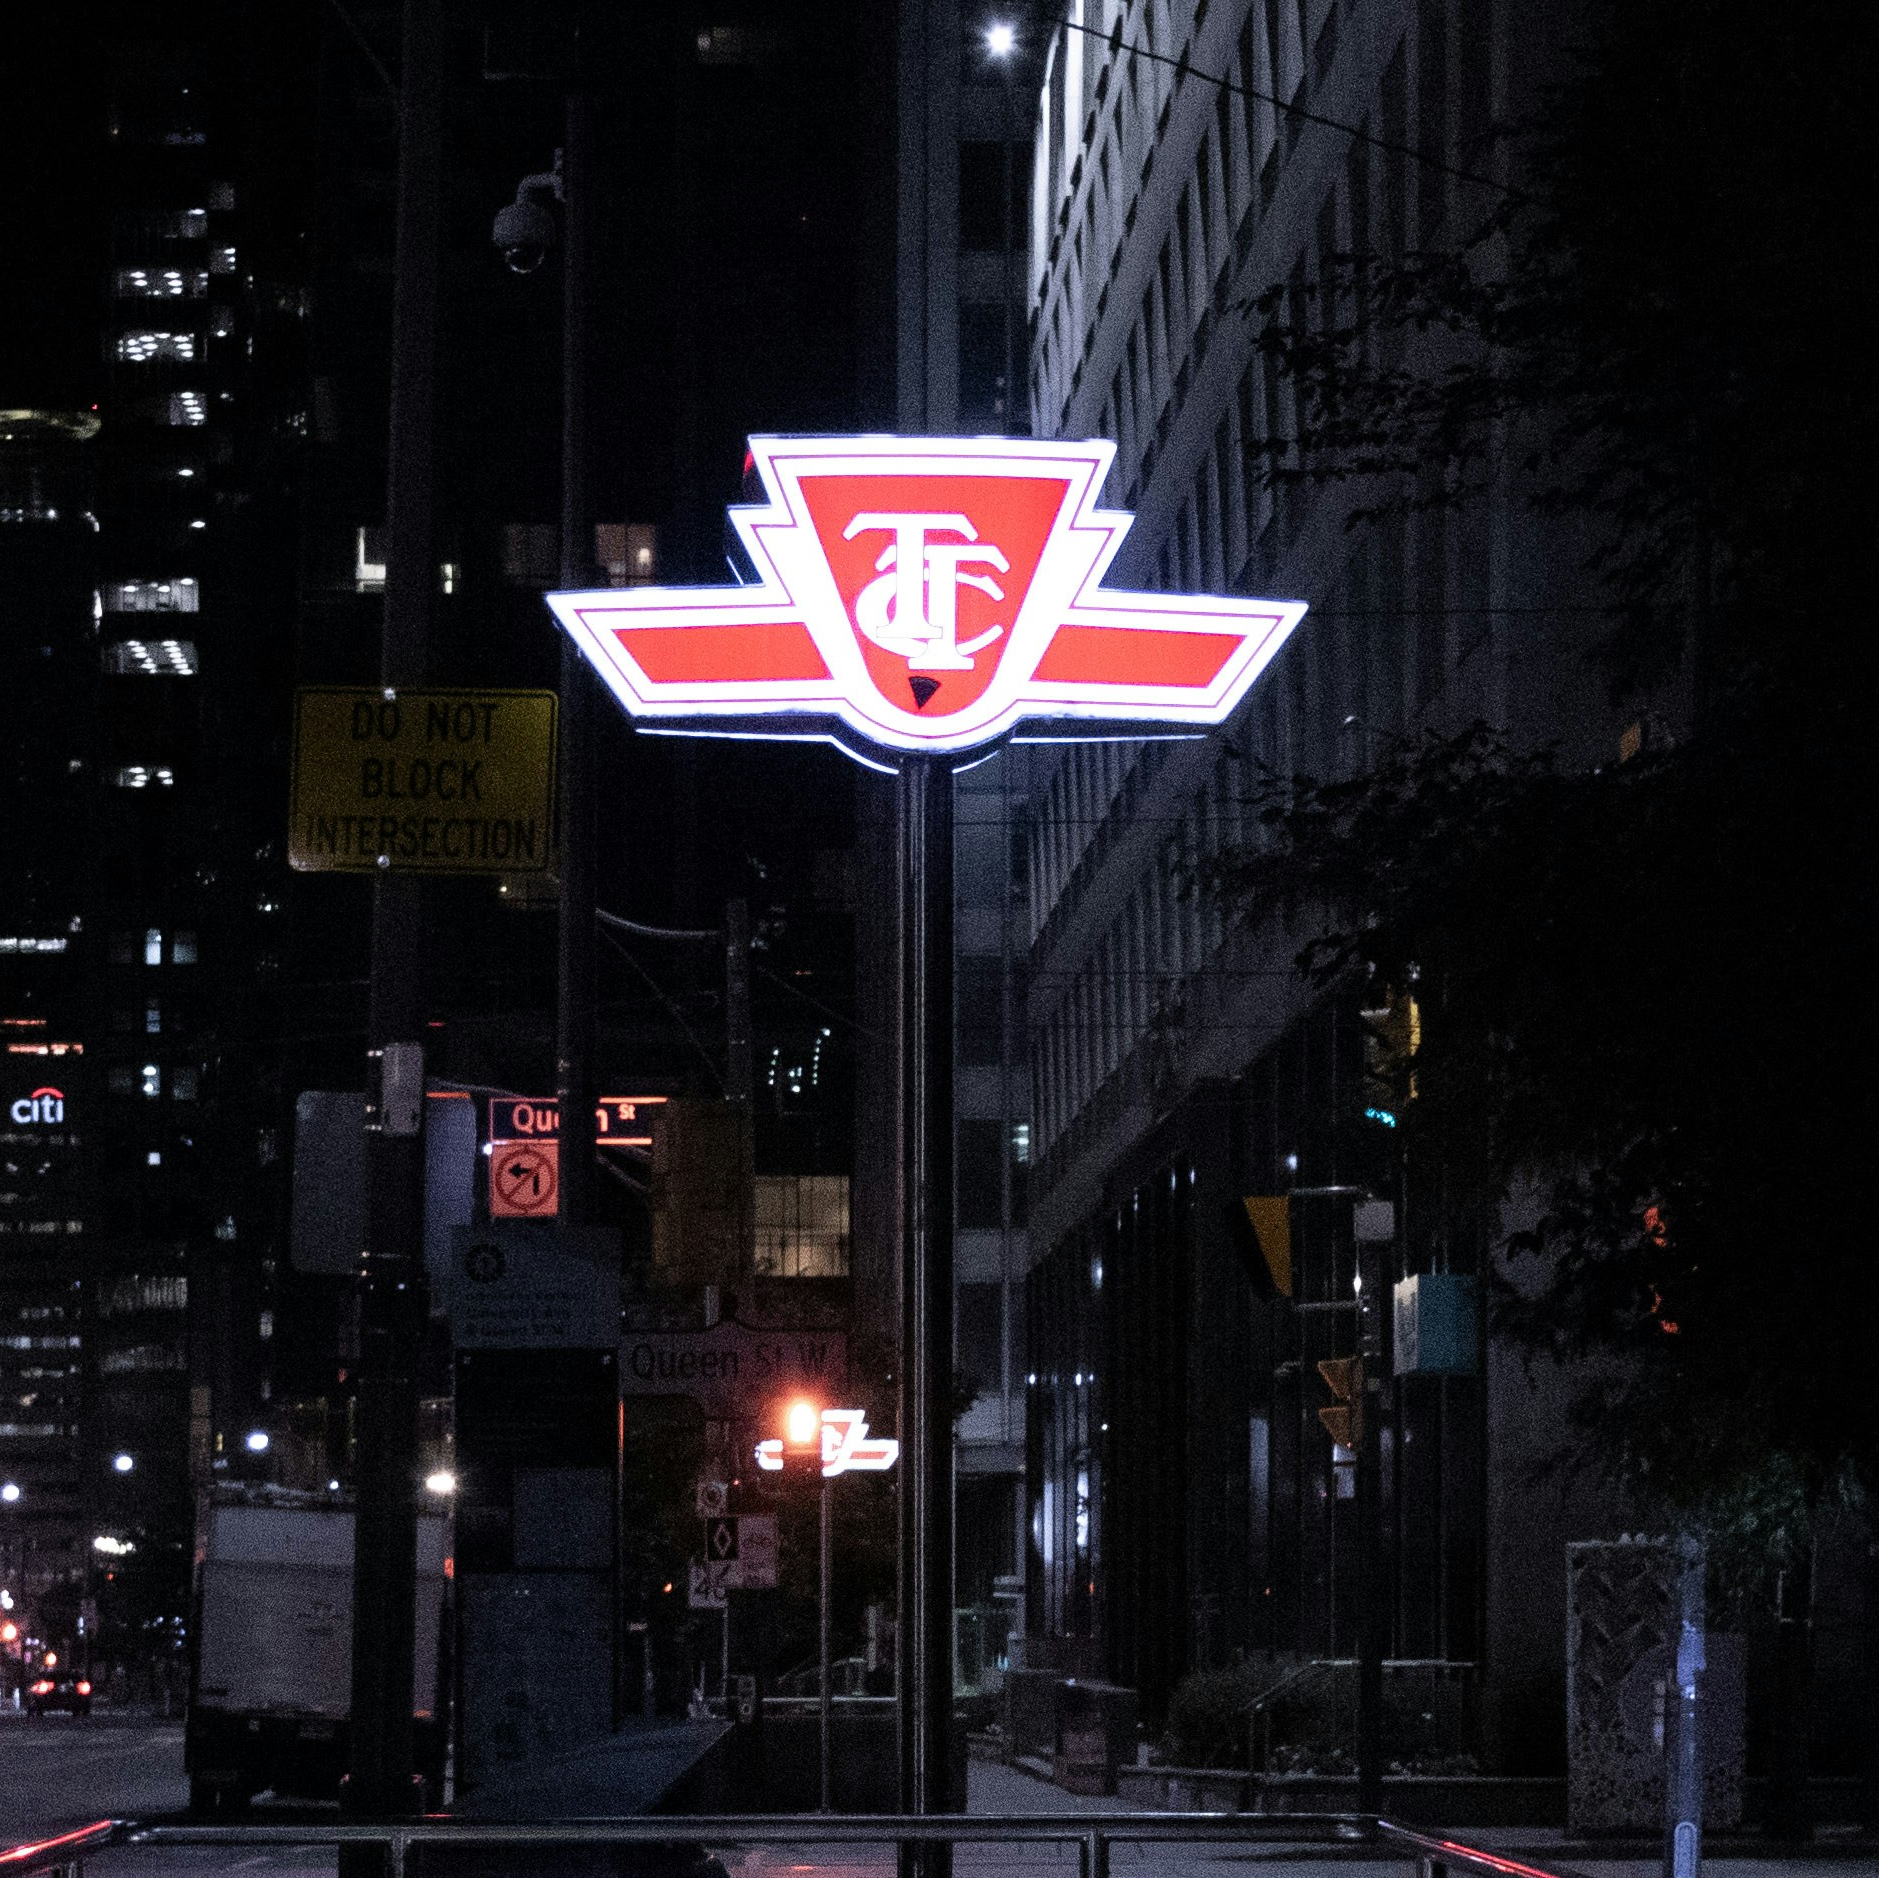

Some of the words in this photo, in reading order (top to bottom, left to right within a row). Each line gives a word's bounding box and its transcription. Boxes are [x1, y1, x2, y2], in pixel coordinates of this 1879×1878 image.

[842, 512, 1011, 670] TTC
[351, 701, 401, 741] DO
[426, 701, 498, 742] NOT
[361, 757, 483, 800] BLOCK
[306, 815, 535, 859] INTERSECTION
[11, 1095, 64, 1123] citi
[512, 1103, 609, 1135] Qun
[618, 1103, 637, 1121] St
[630, 1343, 739, 1380] Queen
[754, 1341, 783, 1379] St
[798, 1340, 827, 1376] W
